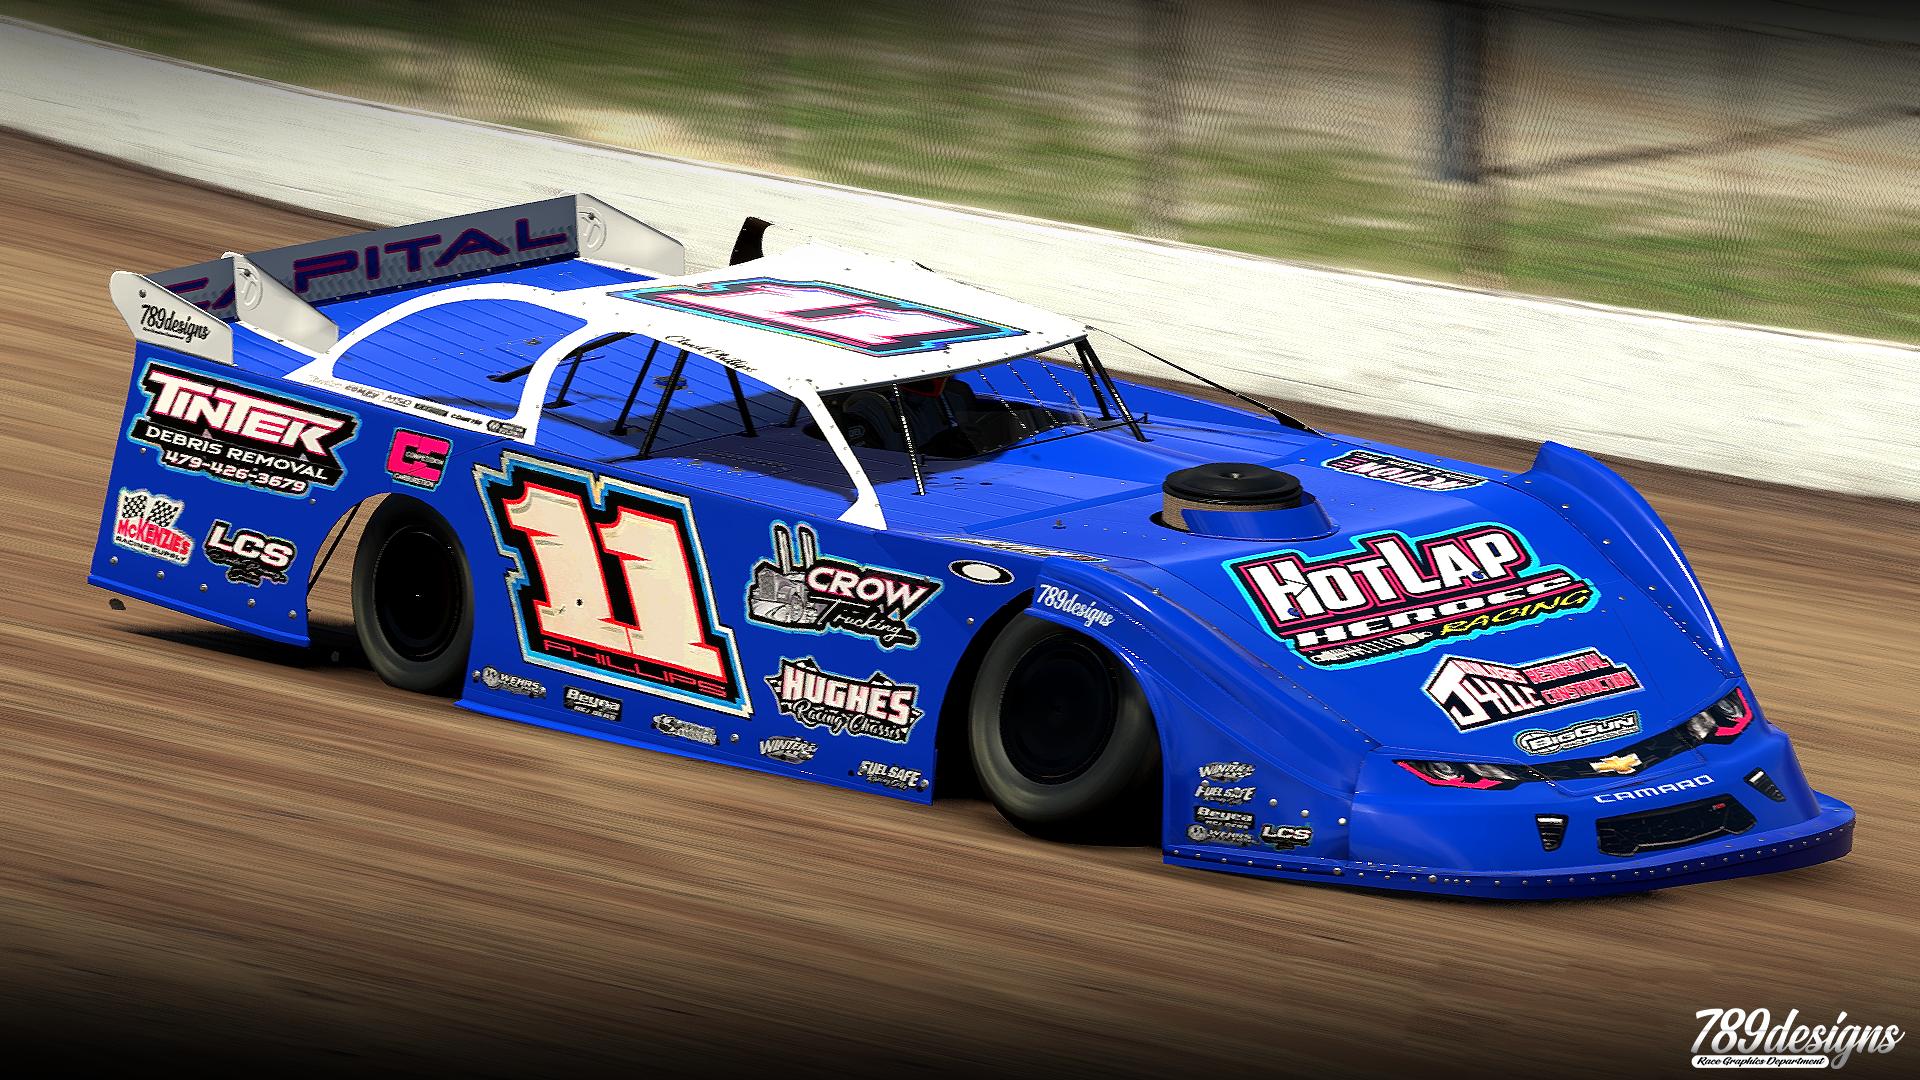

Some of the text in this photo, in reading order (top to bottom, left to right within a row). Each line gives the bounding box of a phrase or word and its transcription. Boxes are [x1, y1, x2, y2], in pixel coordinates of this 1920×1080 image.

[141, 304, 211, 343] 789designs
[148, 370, 346, 457] TINTEK
[145, 426, 328, 480] DEBRIS REMOVAL
[165, 450, 307, 492] 479-426-3679
[208, 525, 293, 567] LCS
[502, 481, 728, 683] 11
[806, 567, 930, 611] CROW
[811, 596, 913, 642] Trucking
[1037, 584, 1116, 628] 789designs
[1440, 589, 1590, 636] RACING
[544, 639, 728, 698] PHILLIPS
[1523, 652, 1611, 685] RESIDENTIAL
[1541, 671, 1637, 705] CONSTRUCTION
[781, 665, 914, 726] HUGHES
[793, 699, 901, 739] Racing Chassis
[1592, 774, 1716, 804] CAMARO
[1262, 826, 1312, 840] LCS
